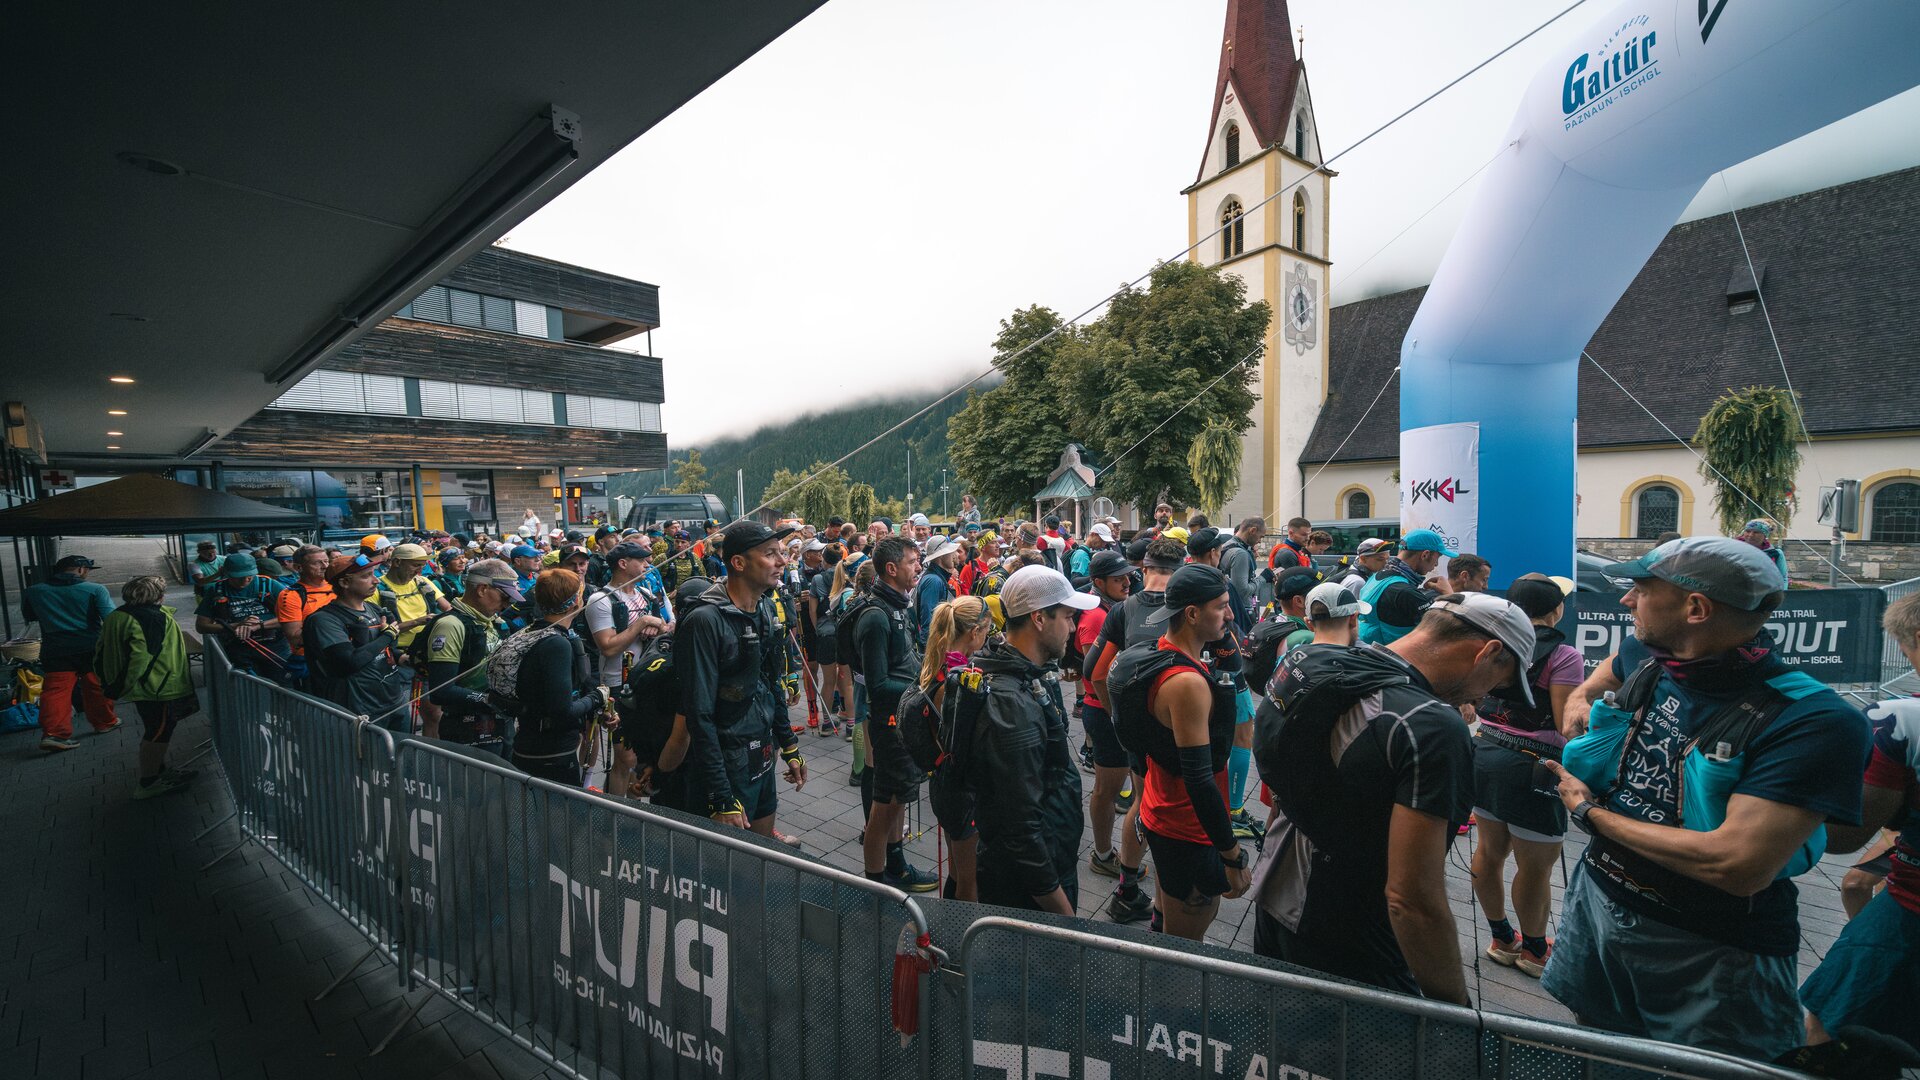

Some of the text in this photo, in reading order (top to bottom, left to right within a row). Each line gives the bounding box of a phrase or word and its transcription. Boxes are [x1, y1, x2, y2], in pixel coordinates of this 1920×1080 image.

[1562, 31, 1656, 114] Galtür
[1565, 67, 1661, 132] PAZNAUN-ISCHGL
[1578, 611, 1615, 621] ULTRA
[1792, 609, 1817, 618] TRAIL
[1811, 655, 1843, 664] ISCHGL
[1619, 789, 1665, 822] 2016
